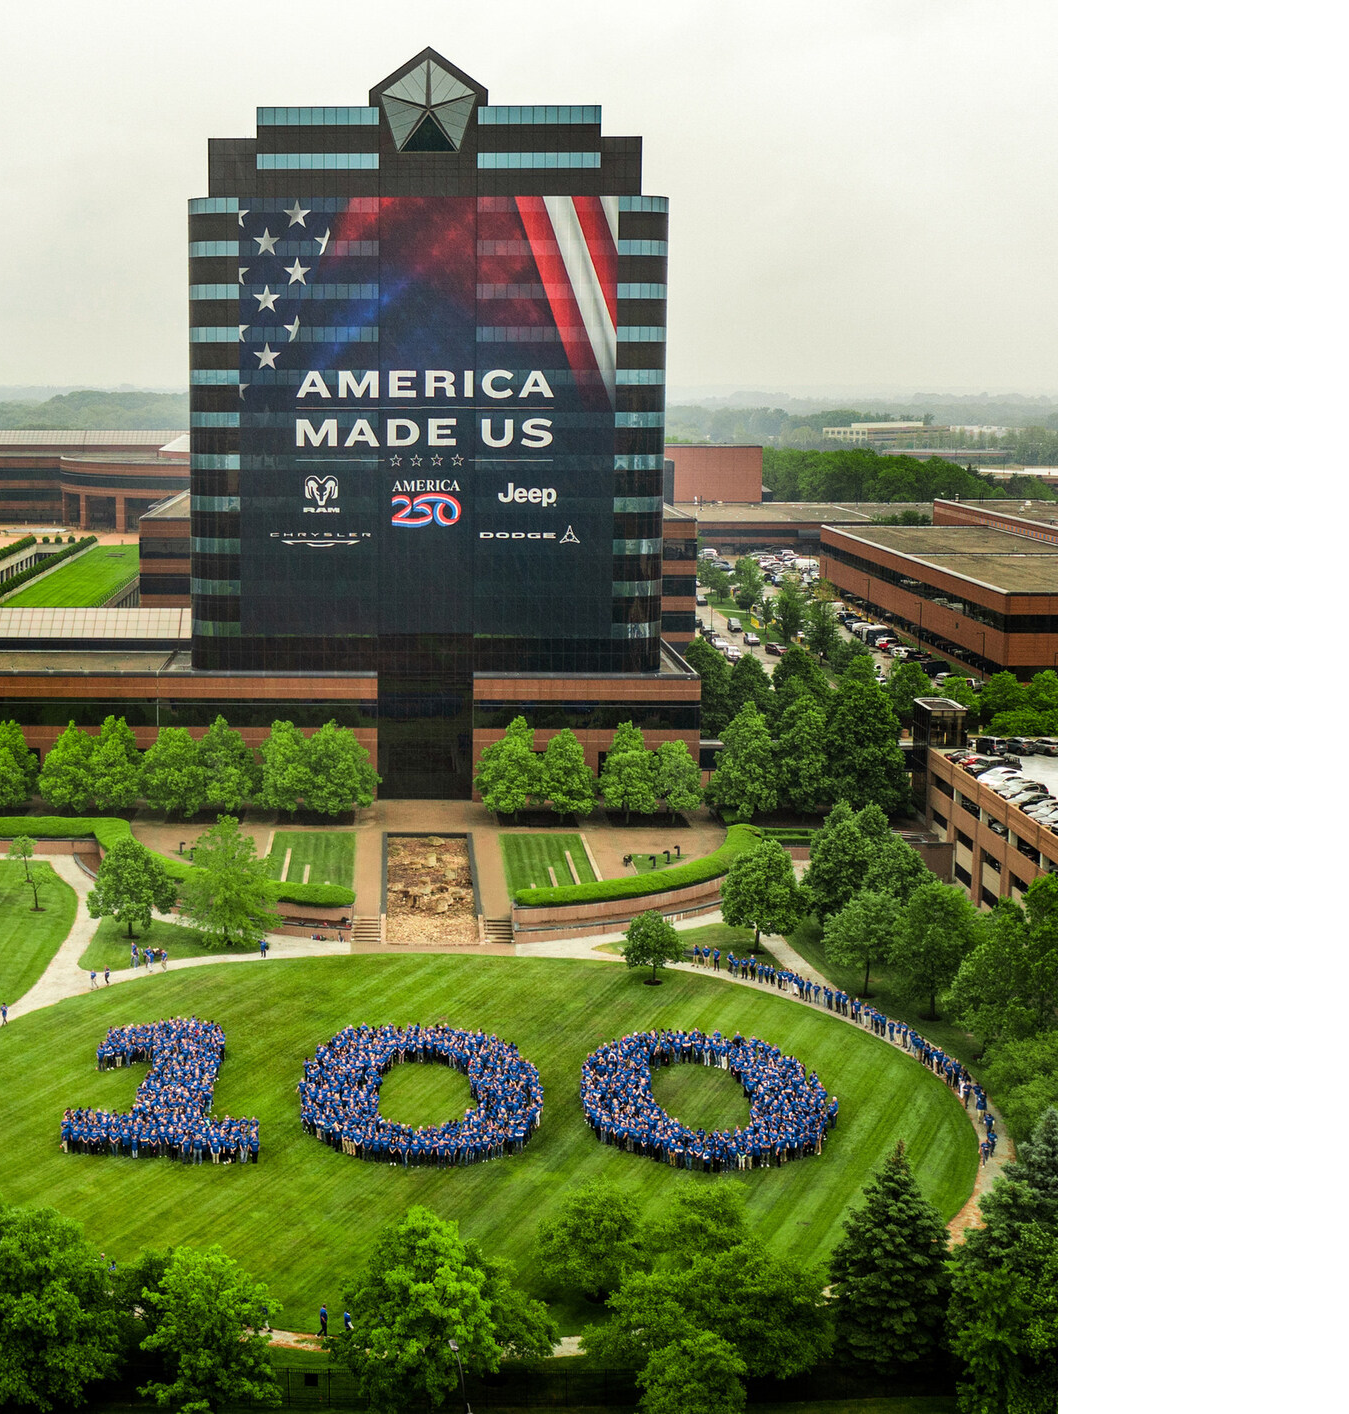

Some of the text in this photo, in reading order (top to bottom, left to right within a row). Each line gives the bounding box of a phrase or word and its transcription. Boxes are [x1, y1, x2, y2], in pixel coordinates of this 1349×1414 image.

[296, 369, 554, 398] AMERICA
[296, 418, 554, 448] MADE US
[392, 480, 461, 492] AMERICA
[498, 482, 557, 507] Jeep
[391, 493, 462, 528] 250
[61, 1015, 839, 1173] 100
